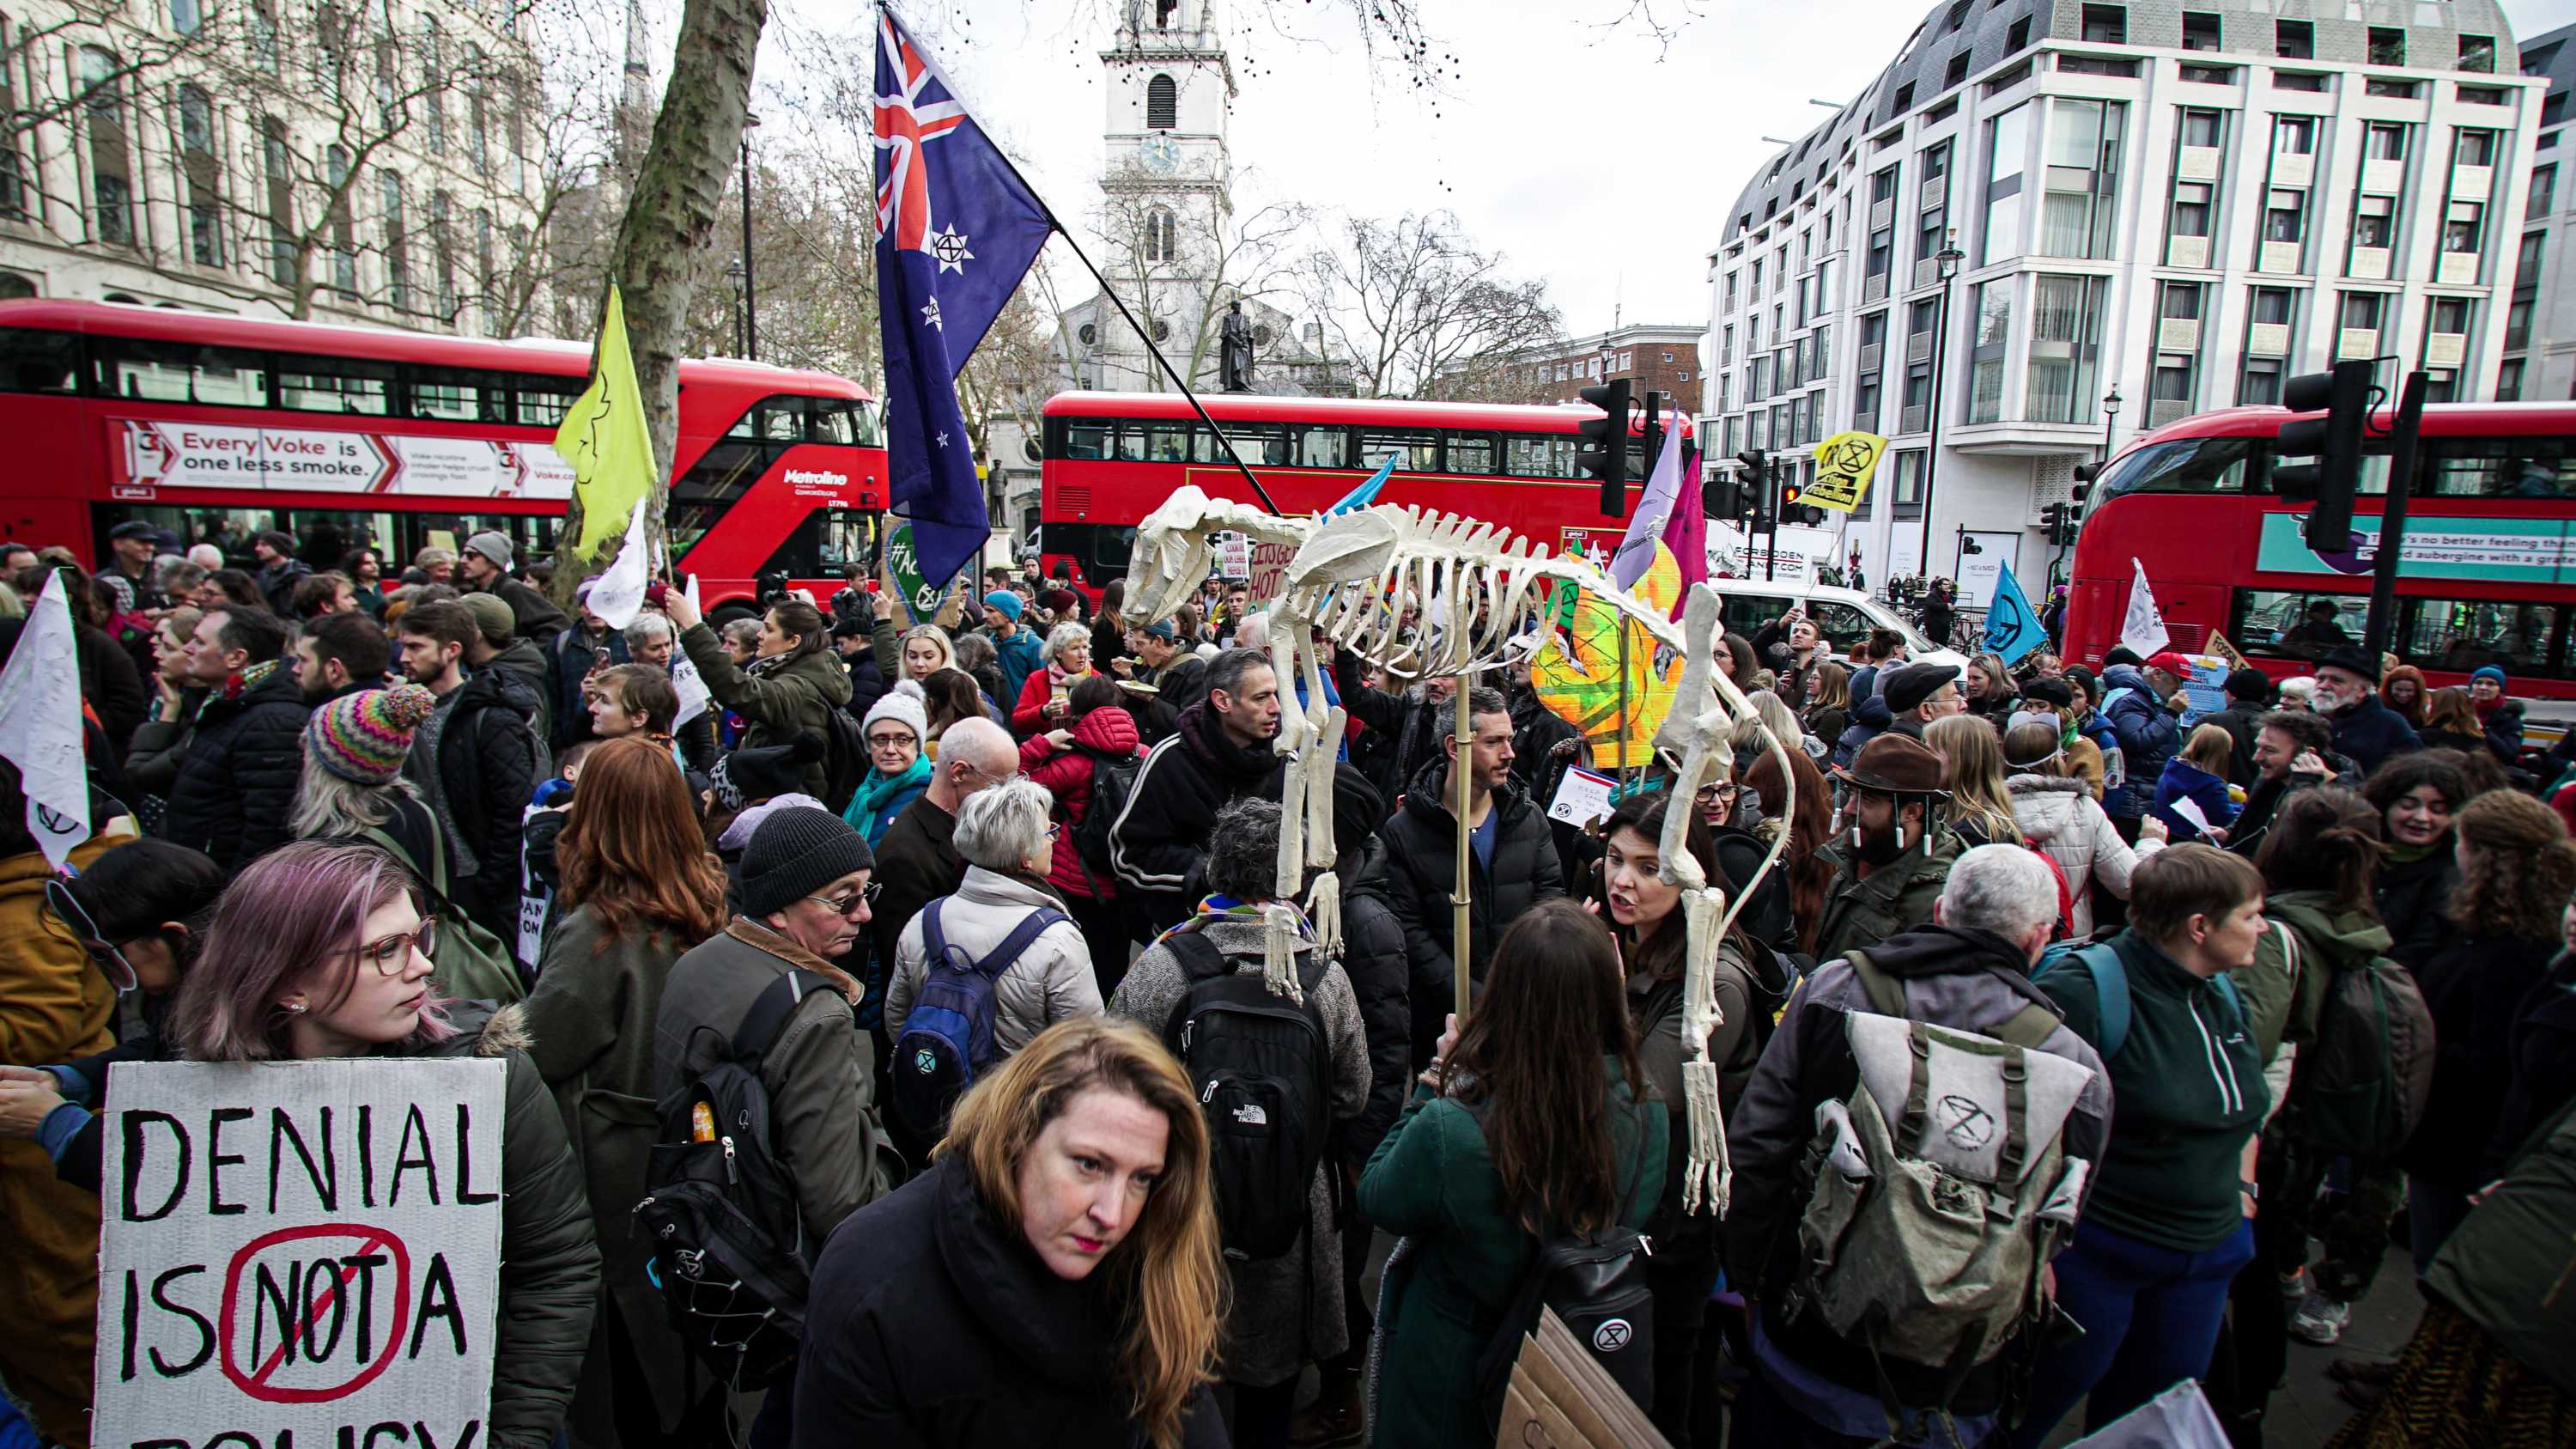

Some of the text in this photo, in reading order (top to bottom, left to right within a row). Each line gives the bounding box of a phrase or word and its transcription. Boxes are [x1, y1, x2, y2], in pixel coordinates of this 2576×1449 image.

[182, 432, 358, 456] Every Voke is
[184, 455, 368, 476] one less smoke.
[783, 469, 848, 485] Metroline
[2421, 536, 2439, 545] no
[2442, 535, 2484, 546] better
[2489, 538, 2537, 549] feeling
[2416, 551, 2484, 562] aubergine
[1249, 568, 1281, 602] HOT
[2213, 636, 2238, 670] FOSSIL
[122, 1103, 500, 1221] DENIAL
[121, 1251, 468, 1382] IS NOT A
